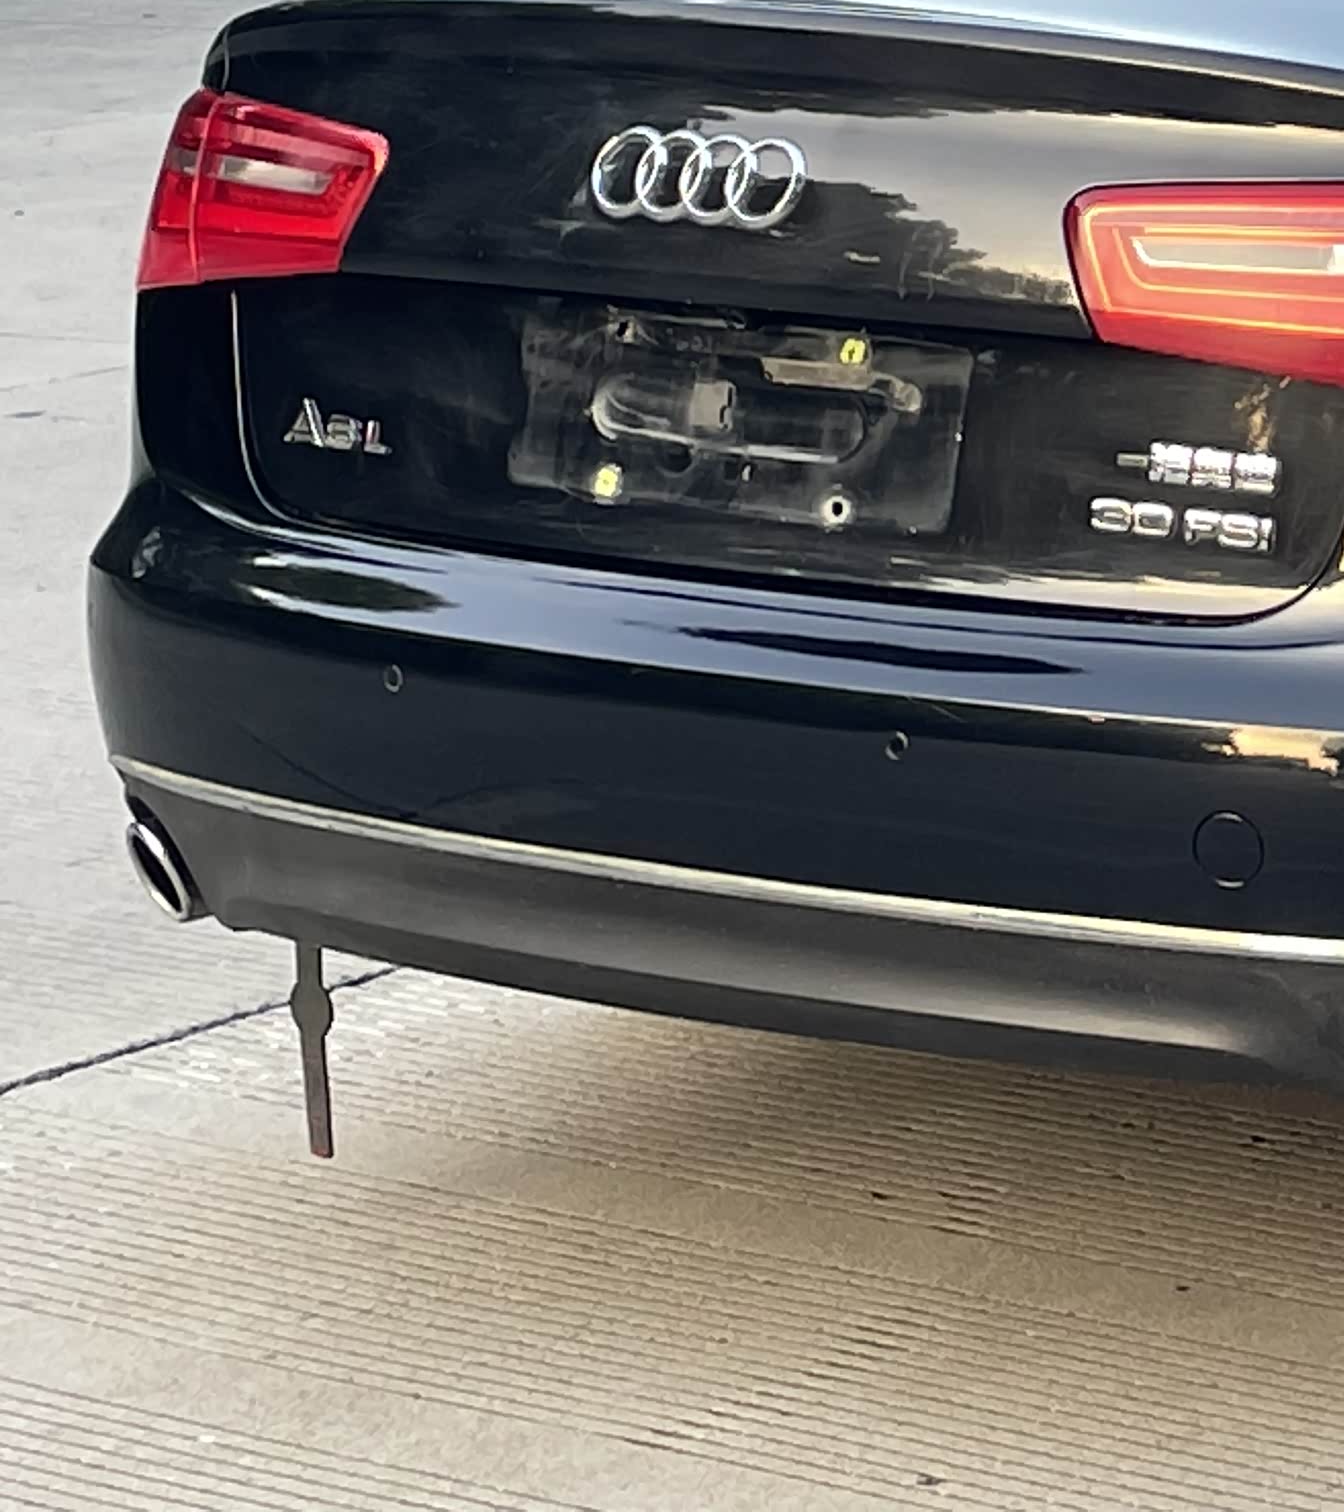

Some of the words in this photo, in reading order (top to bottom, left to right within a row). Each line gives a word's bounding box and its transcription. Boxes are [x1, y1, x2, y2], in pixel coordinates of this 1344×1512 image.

[283, 397, 393, 455] A6L
[1090, 497, 1174, 537] 30
[1183, 508, 1276, 553] FSI
